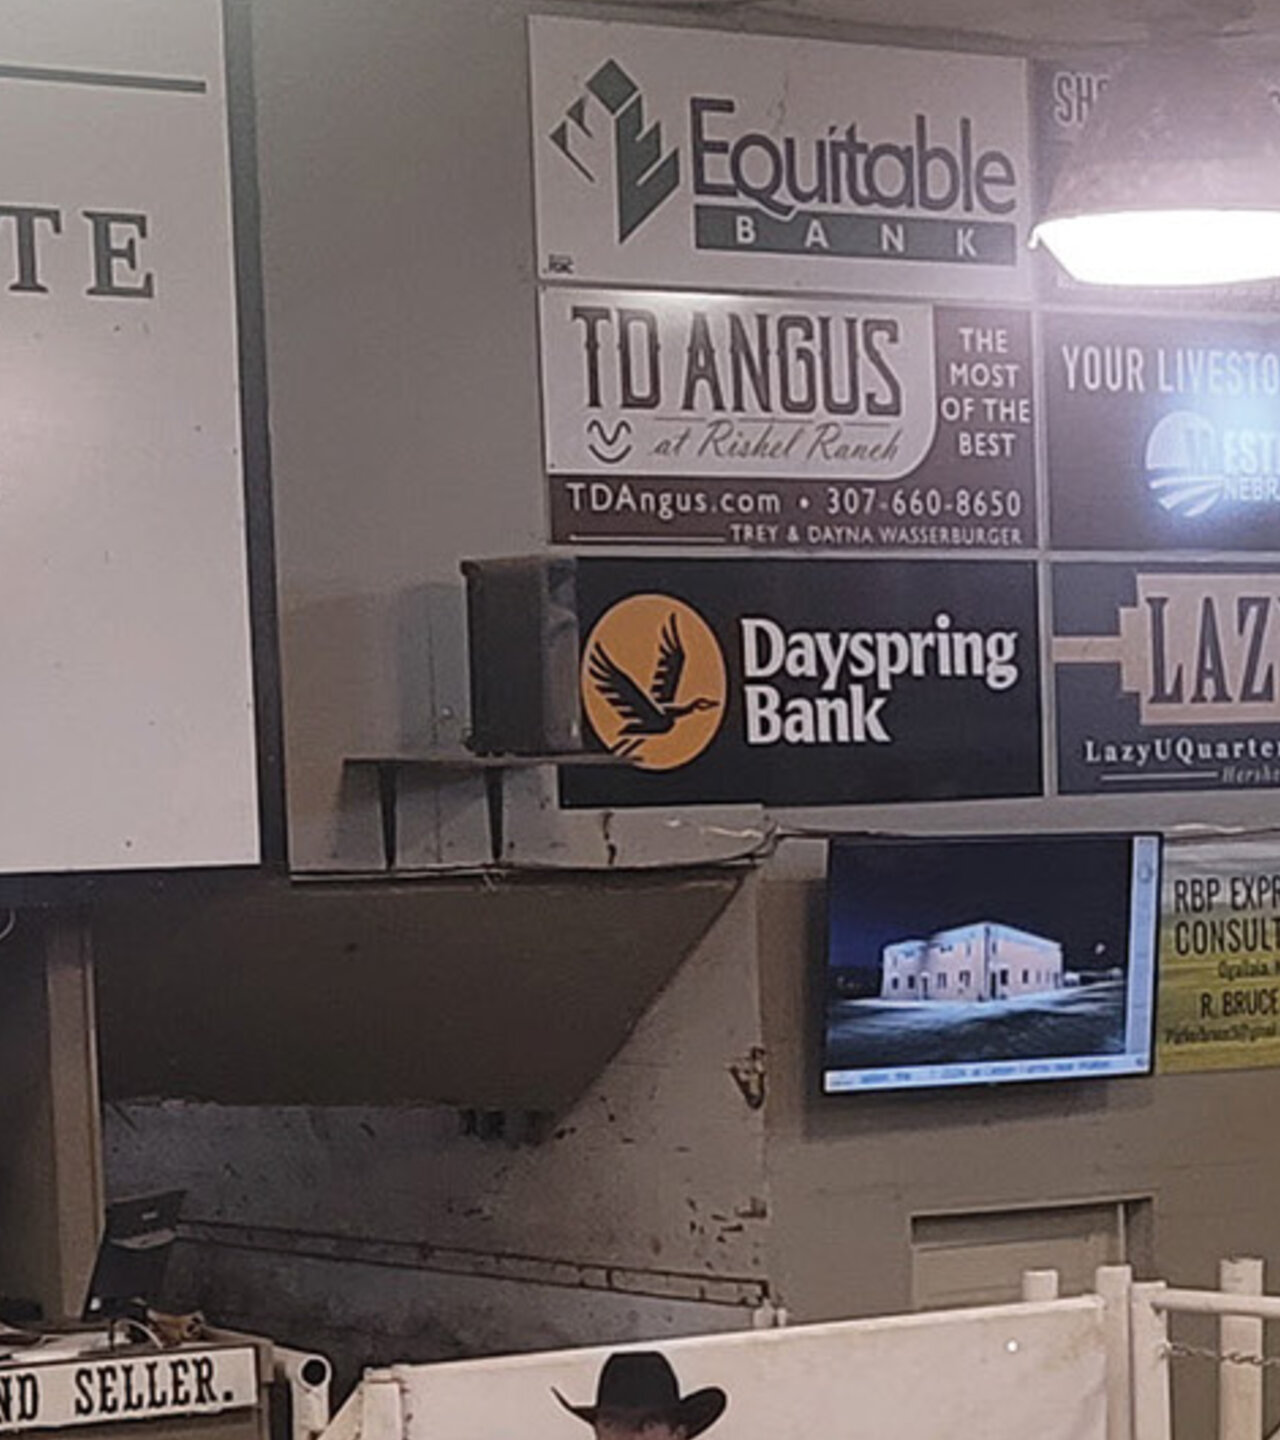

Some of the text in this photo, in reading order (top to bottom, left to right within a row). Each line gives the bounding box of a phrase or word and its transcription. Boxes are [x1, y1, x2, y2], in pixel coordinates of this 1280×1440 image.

[690, 97, 1017, 218] Equitable
[735, 214, 977, 257] BANK
[959, 327, 1009, 354] THE
[572, 305, 903, 417] TD ANGUS
[949, 362, 1020, 390] MOST
[1061, 344, 1146, 393] YOUR
[941, 397, 1032, 425] OF THE
[650, 424, 685, 457] at
[805, 422, 904, 464] Ranch
[958, 431, 1016, 459] BEST
[566, 481, 1022, 520] TDAngus.com 307-660-8650
[730, 523, 1023, 547] TREY & DAYNA WASSERBURGER
[739, 612, 1020, 692] Dayspring
[742, 684, 892, 745] Bank
[1174, 877, 1220, 914] RBP
[1222, 988, 1280, 1017] BRUCE
[73, 1356, 235, 1417] SELLER.
